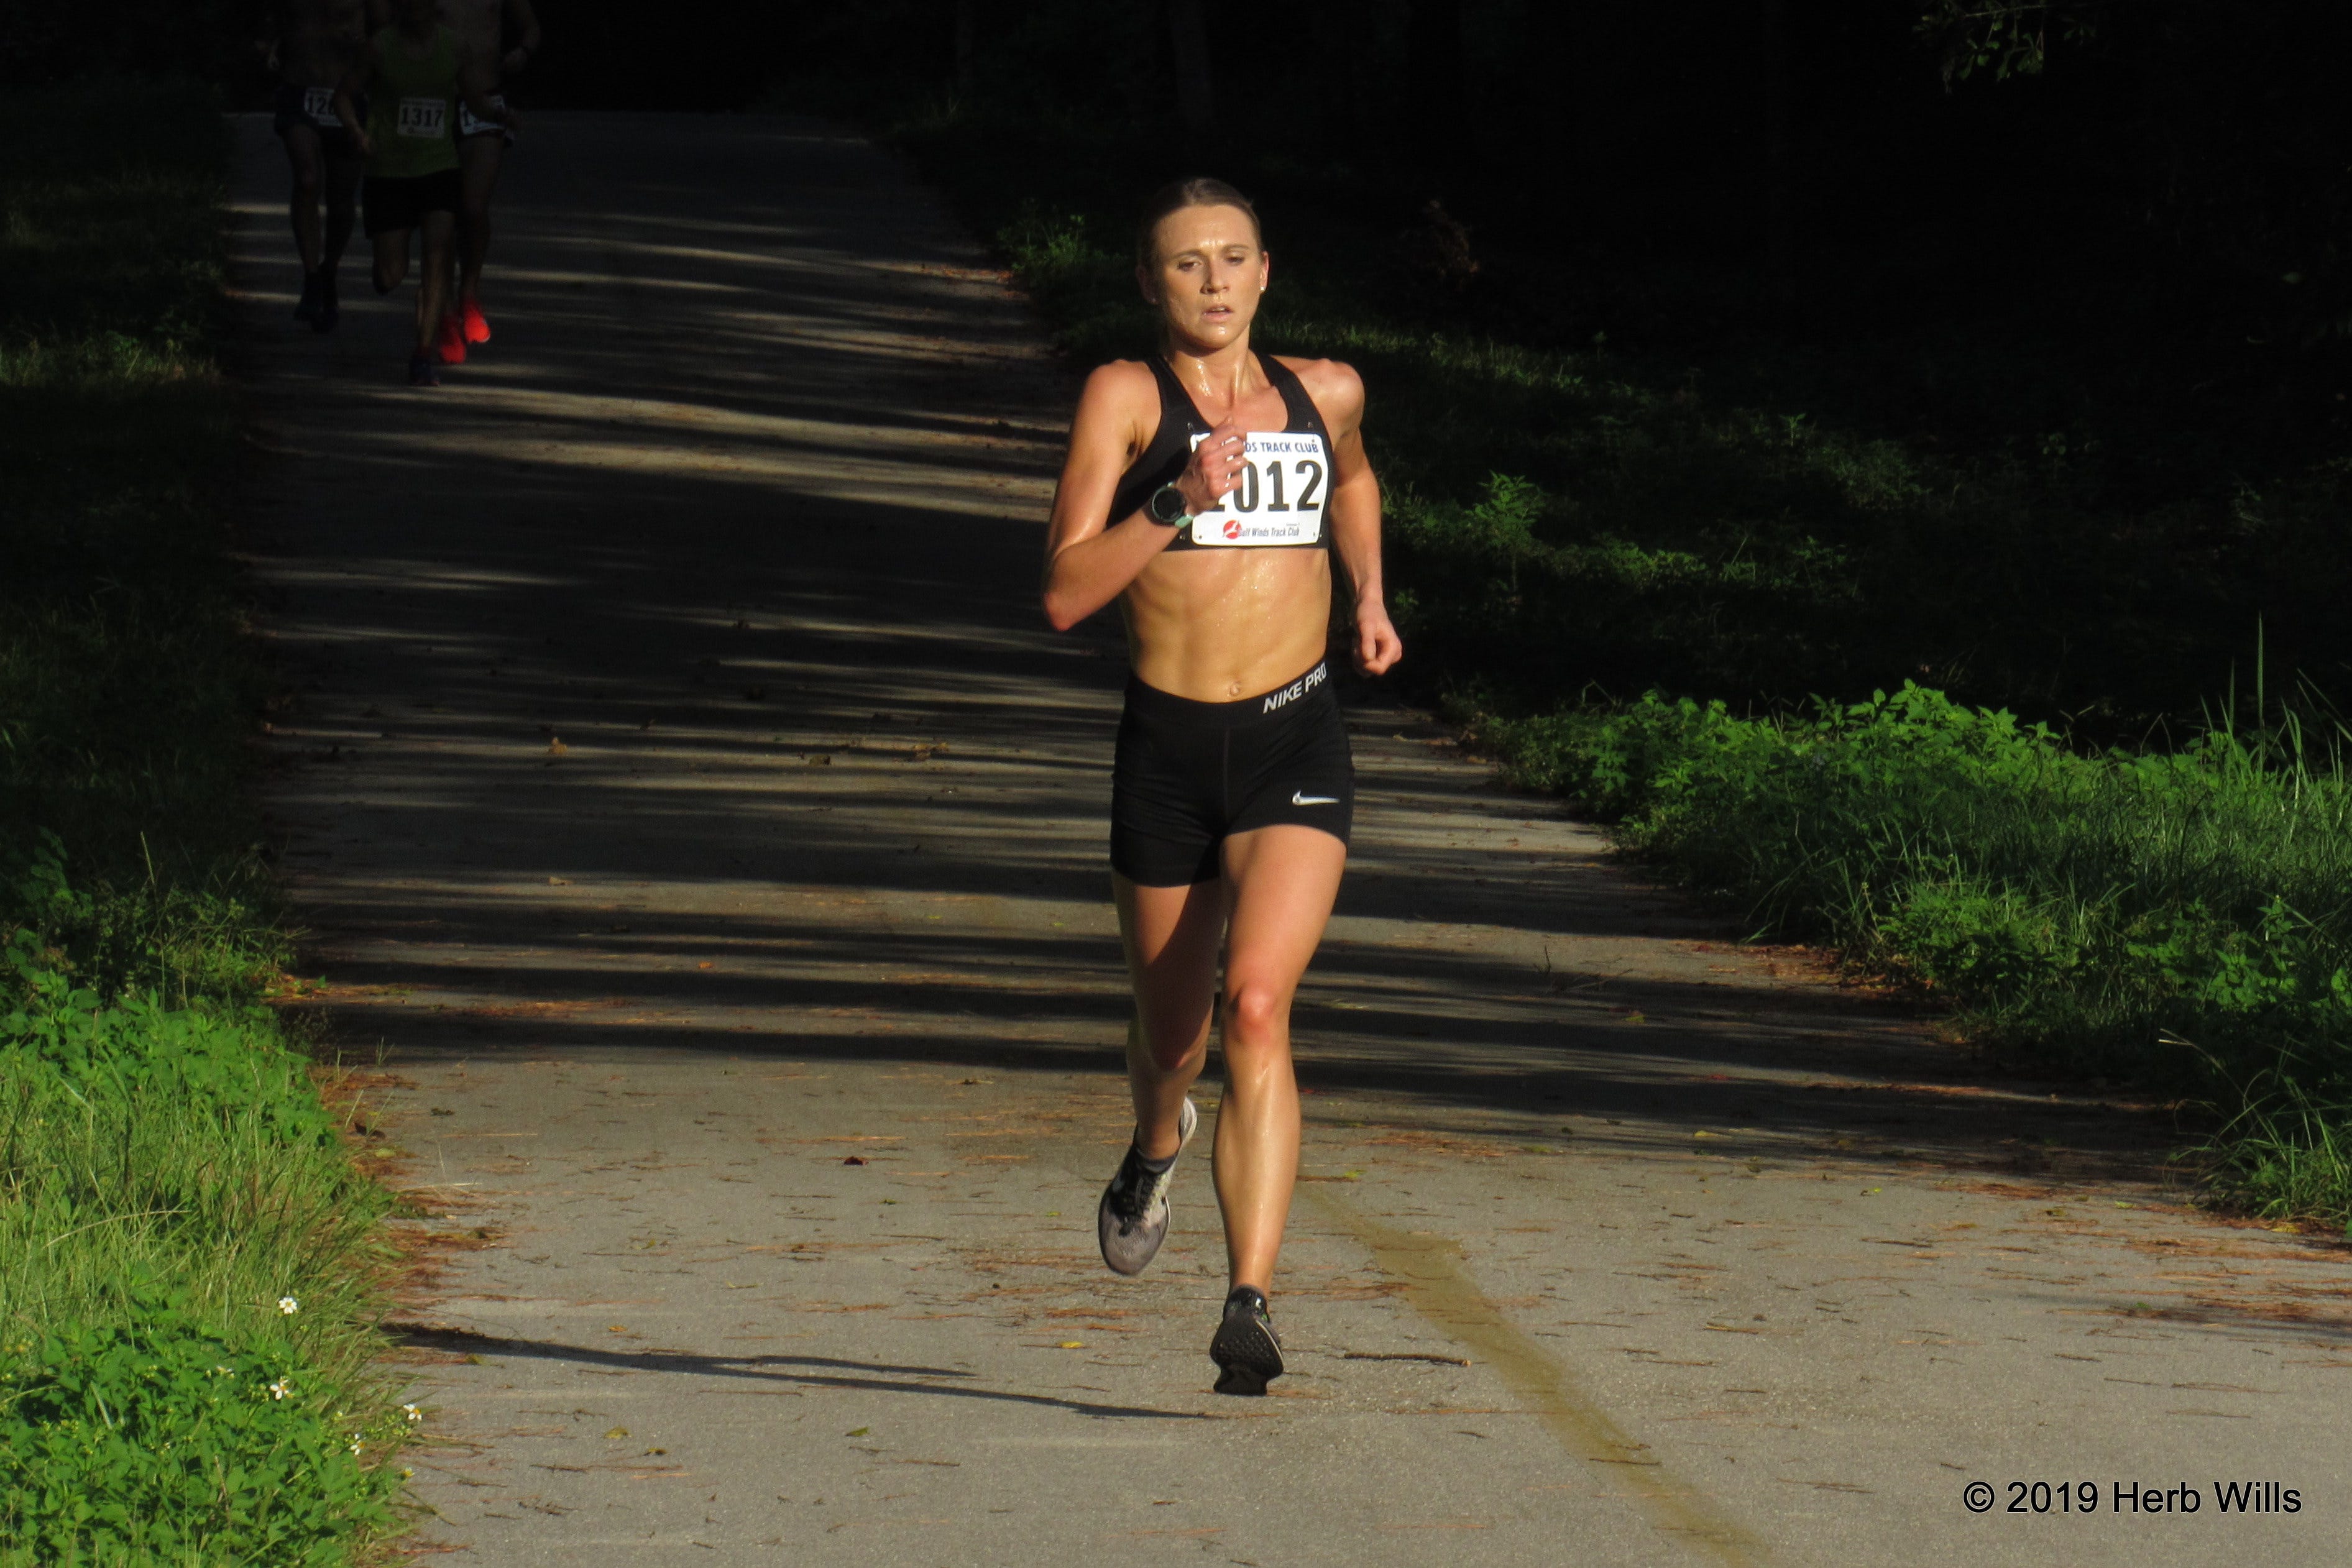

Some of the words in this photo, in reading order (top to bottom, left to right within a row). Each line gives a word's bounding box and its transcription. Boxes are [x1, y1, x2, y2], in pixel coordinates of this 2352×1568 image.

[401, 106, 443, 127] 1317
[1245, 442, 1257, 452] DS
[1260, 442, 1292, 452] TRACK
[1295, 442, 1318, 452] CLUB
[1207, 459, 1323, 513] 012
[1252, 527, 1269, 537] Winds
[1271, 527, 1286, 537] Track
[1288, 526, 1300, 536] Club
[1263, 680, 1303, 714] NIKE
[1305, 661, 1327, 693] PRO
